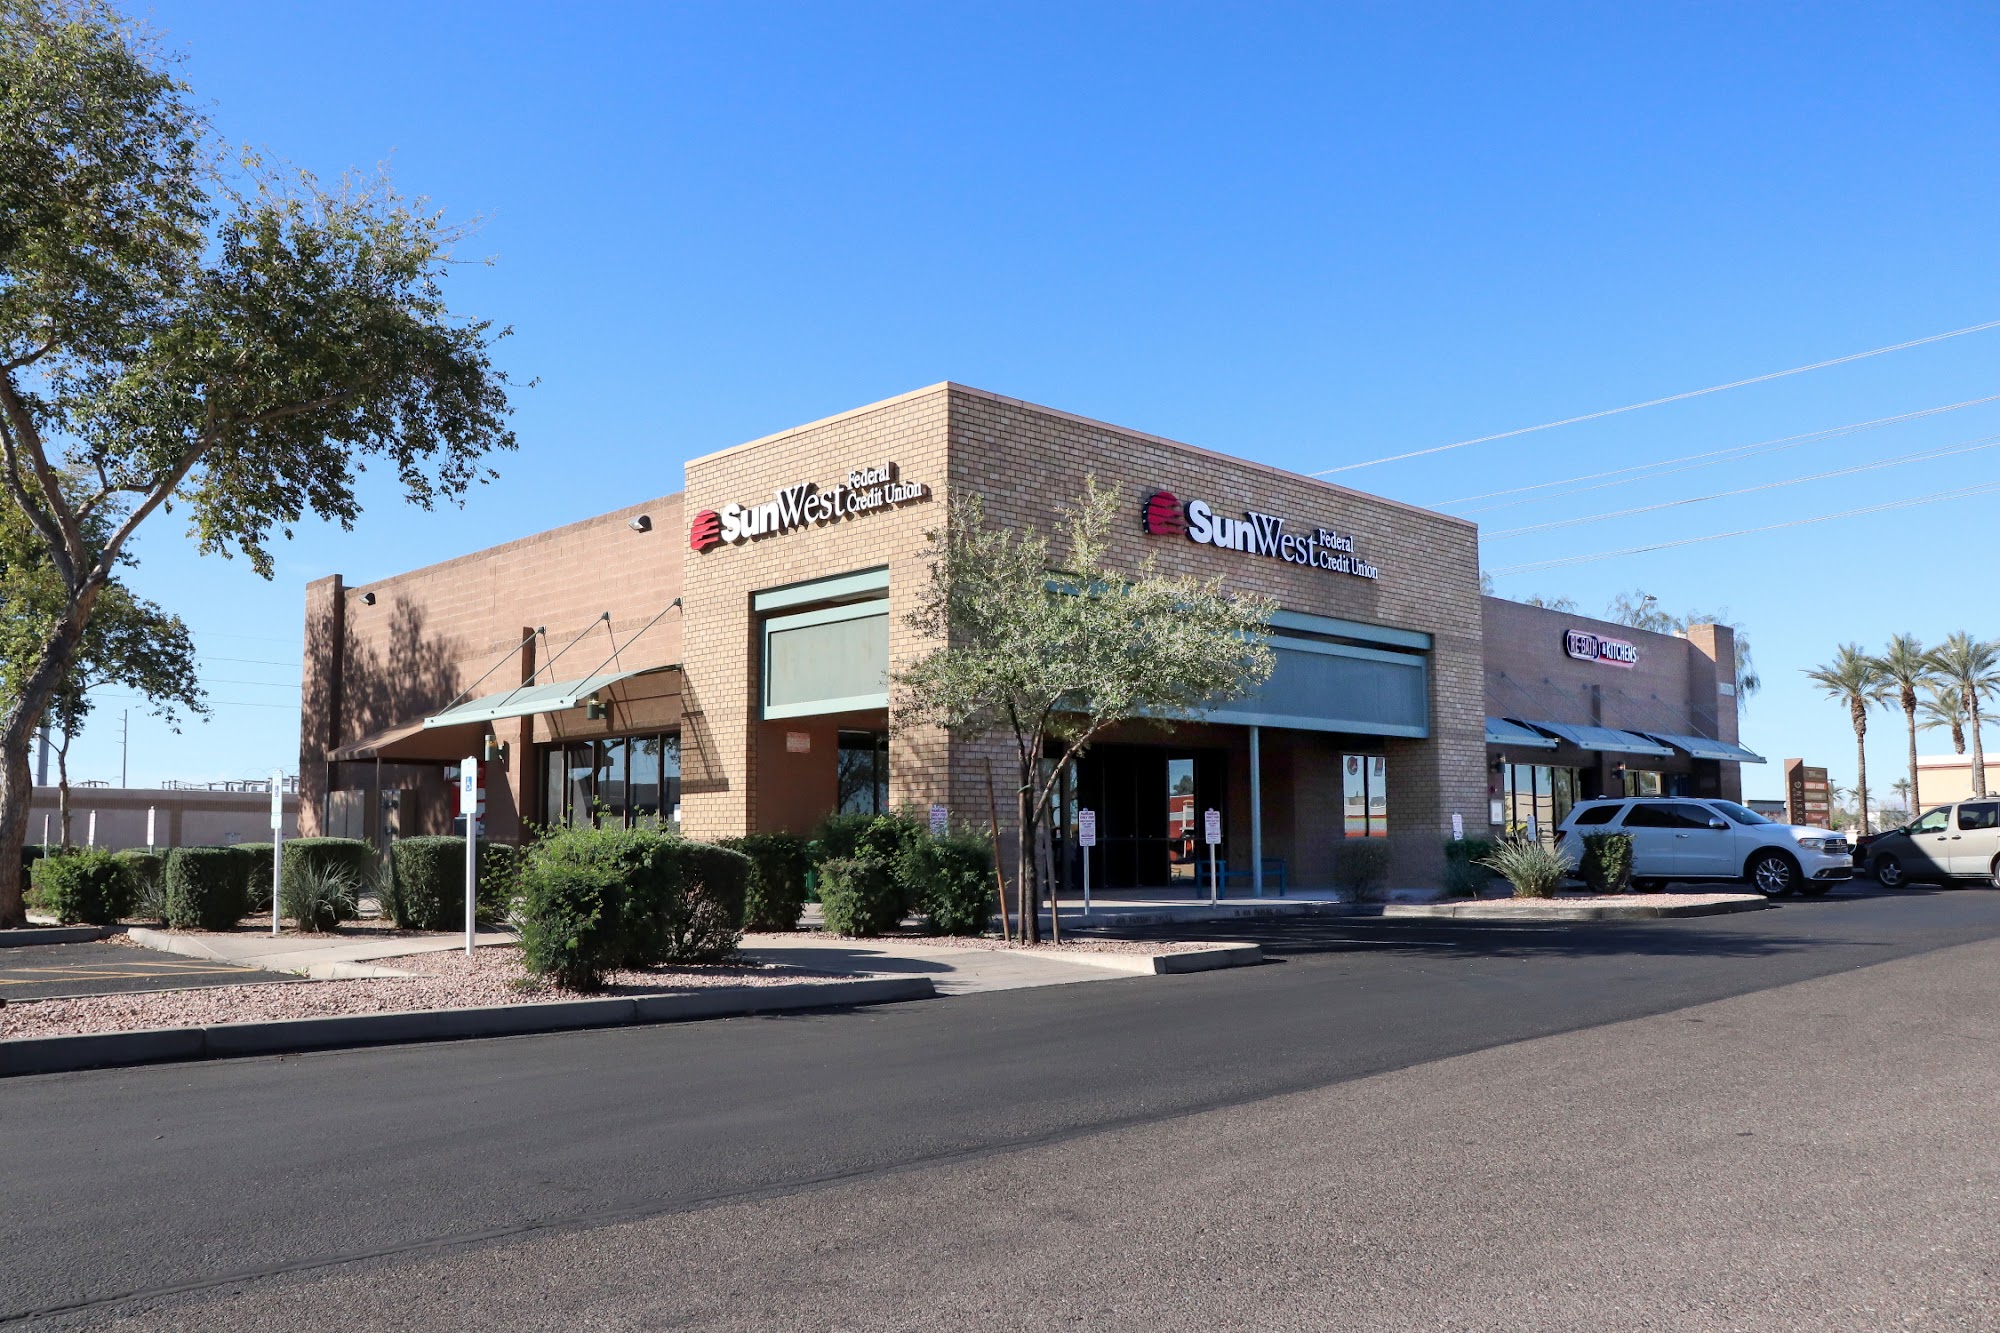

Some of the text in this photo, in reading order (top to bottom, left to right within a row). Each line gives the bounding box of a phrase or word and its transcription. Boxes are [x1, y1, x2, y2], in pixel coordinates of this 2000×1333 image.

[847, 462, 890, 490] Federal
[846, 481, 922, 513] Credit Union
[721, 482, 845, 542] SunWest
[1188, 499, 1319, 568] SunWest
[1319, 528, 1355, 553] Federal
[1319, 551, 1379, 580] Credit Union
[1570, 634, 1598, 656] RE-BATH
[1606, 641, 1637, 663] KITCHENS
